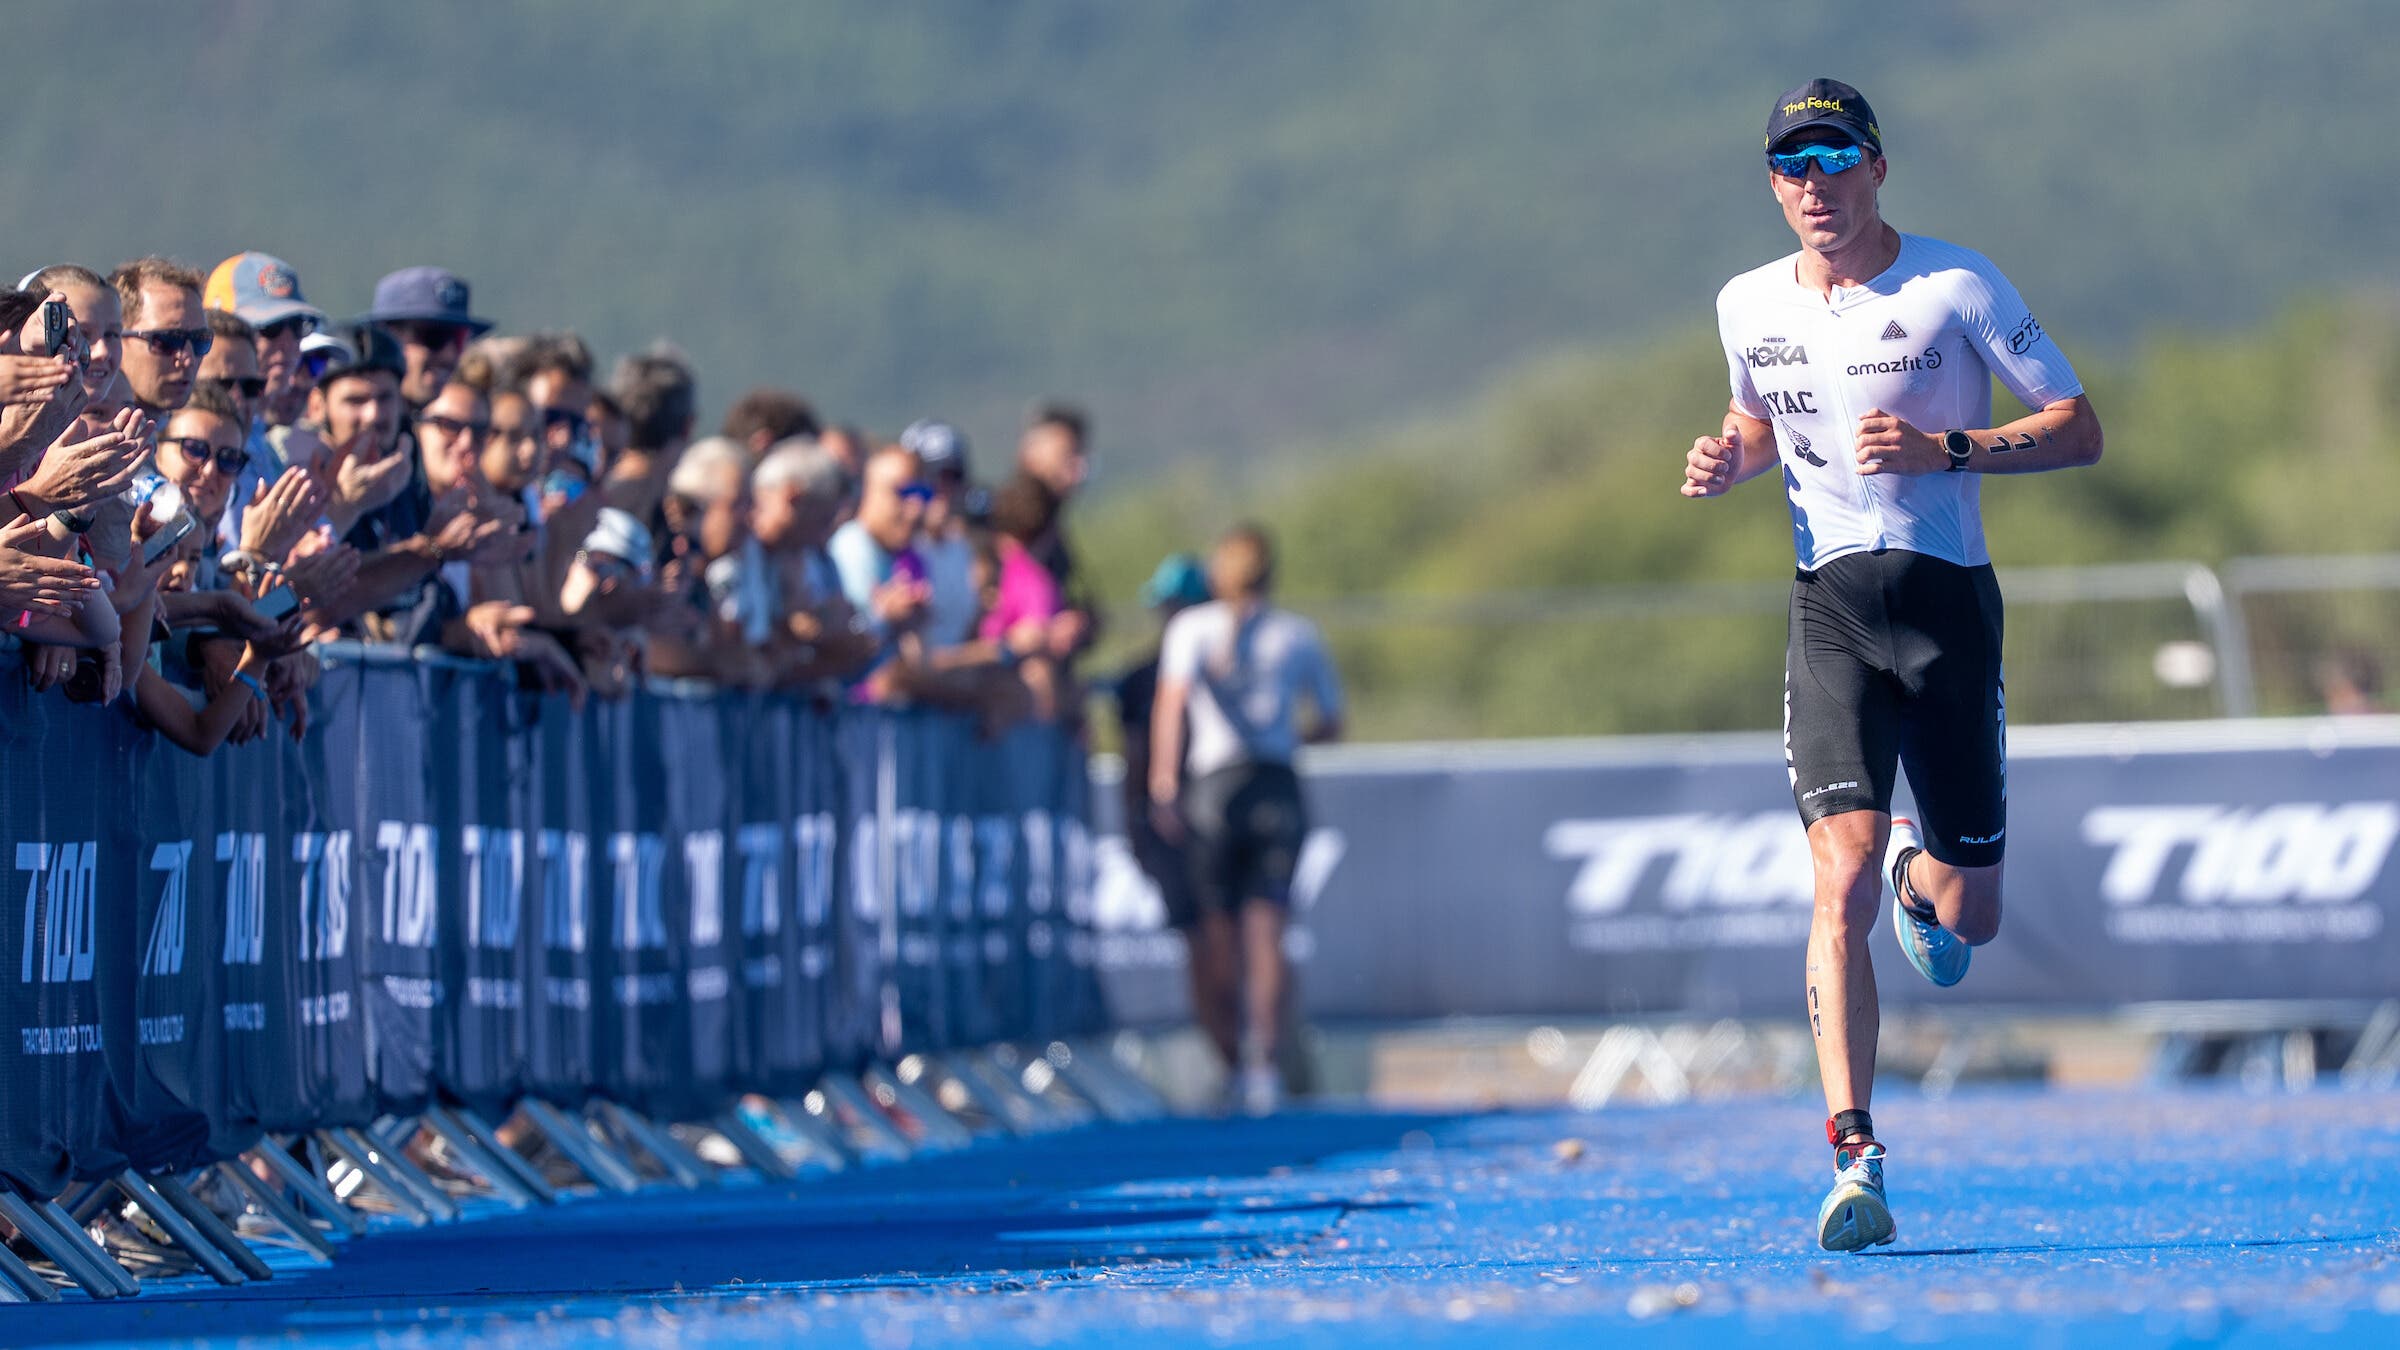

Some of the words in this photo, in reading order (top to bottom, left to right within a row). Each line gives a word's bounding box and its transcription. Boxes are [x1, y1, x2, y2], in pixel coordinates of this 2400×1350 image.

[1783, 100, 1805, 117] The
[1746, 345, 1808, 368] HOKA
[1846, 355, 1923, 376] amazfit
[2078, 803, 2398, 902] T100
[15, 841, 97, 983] T100
